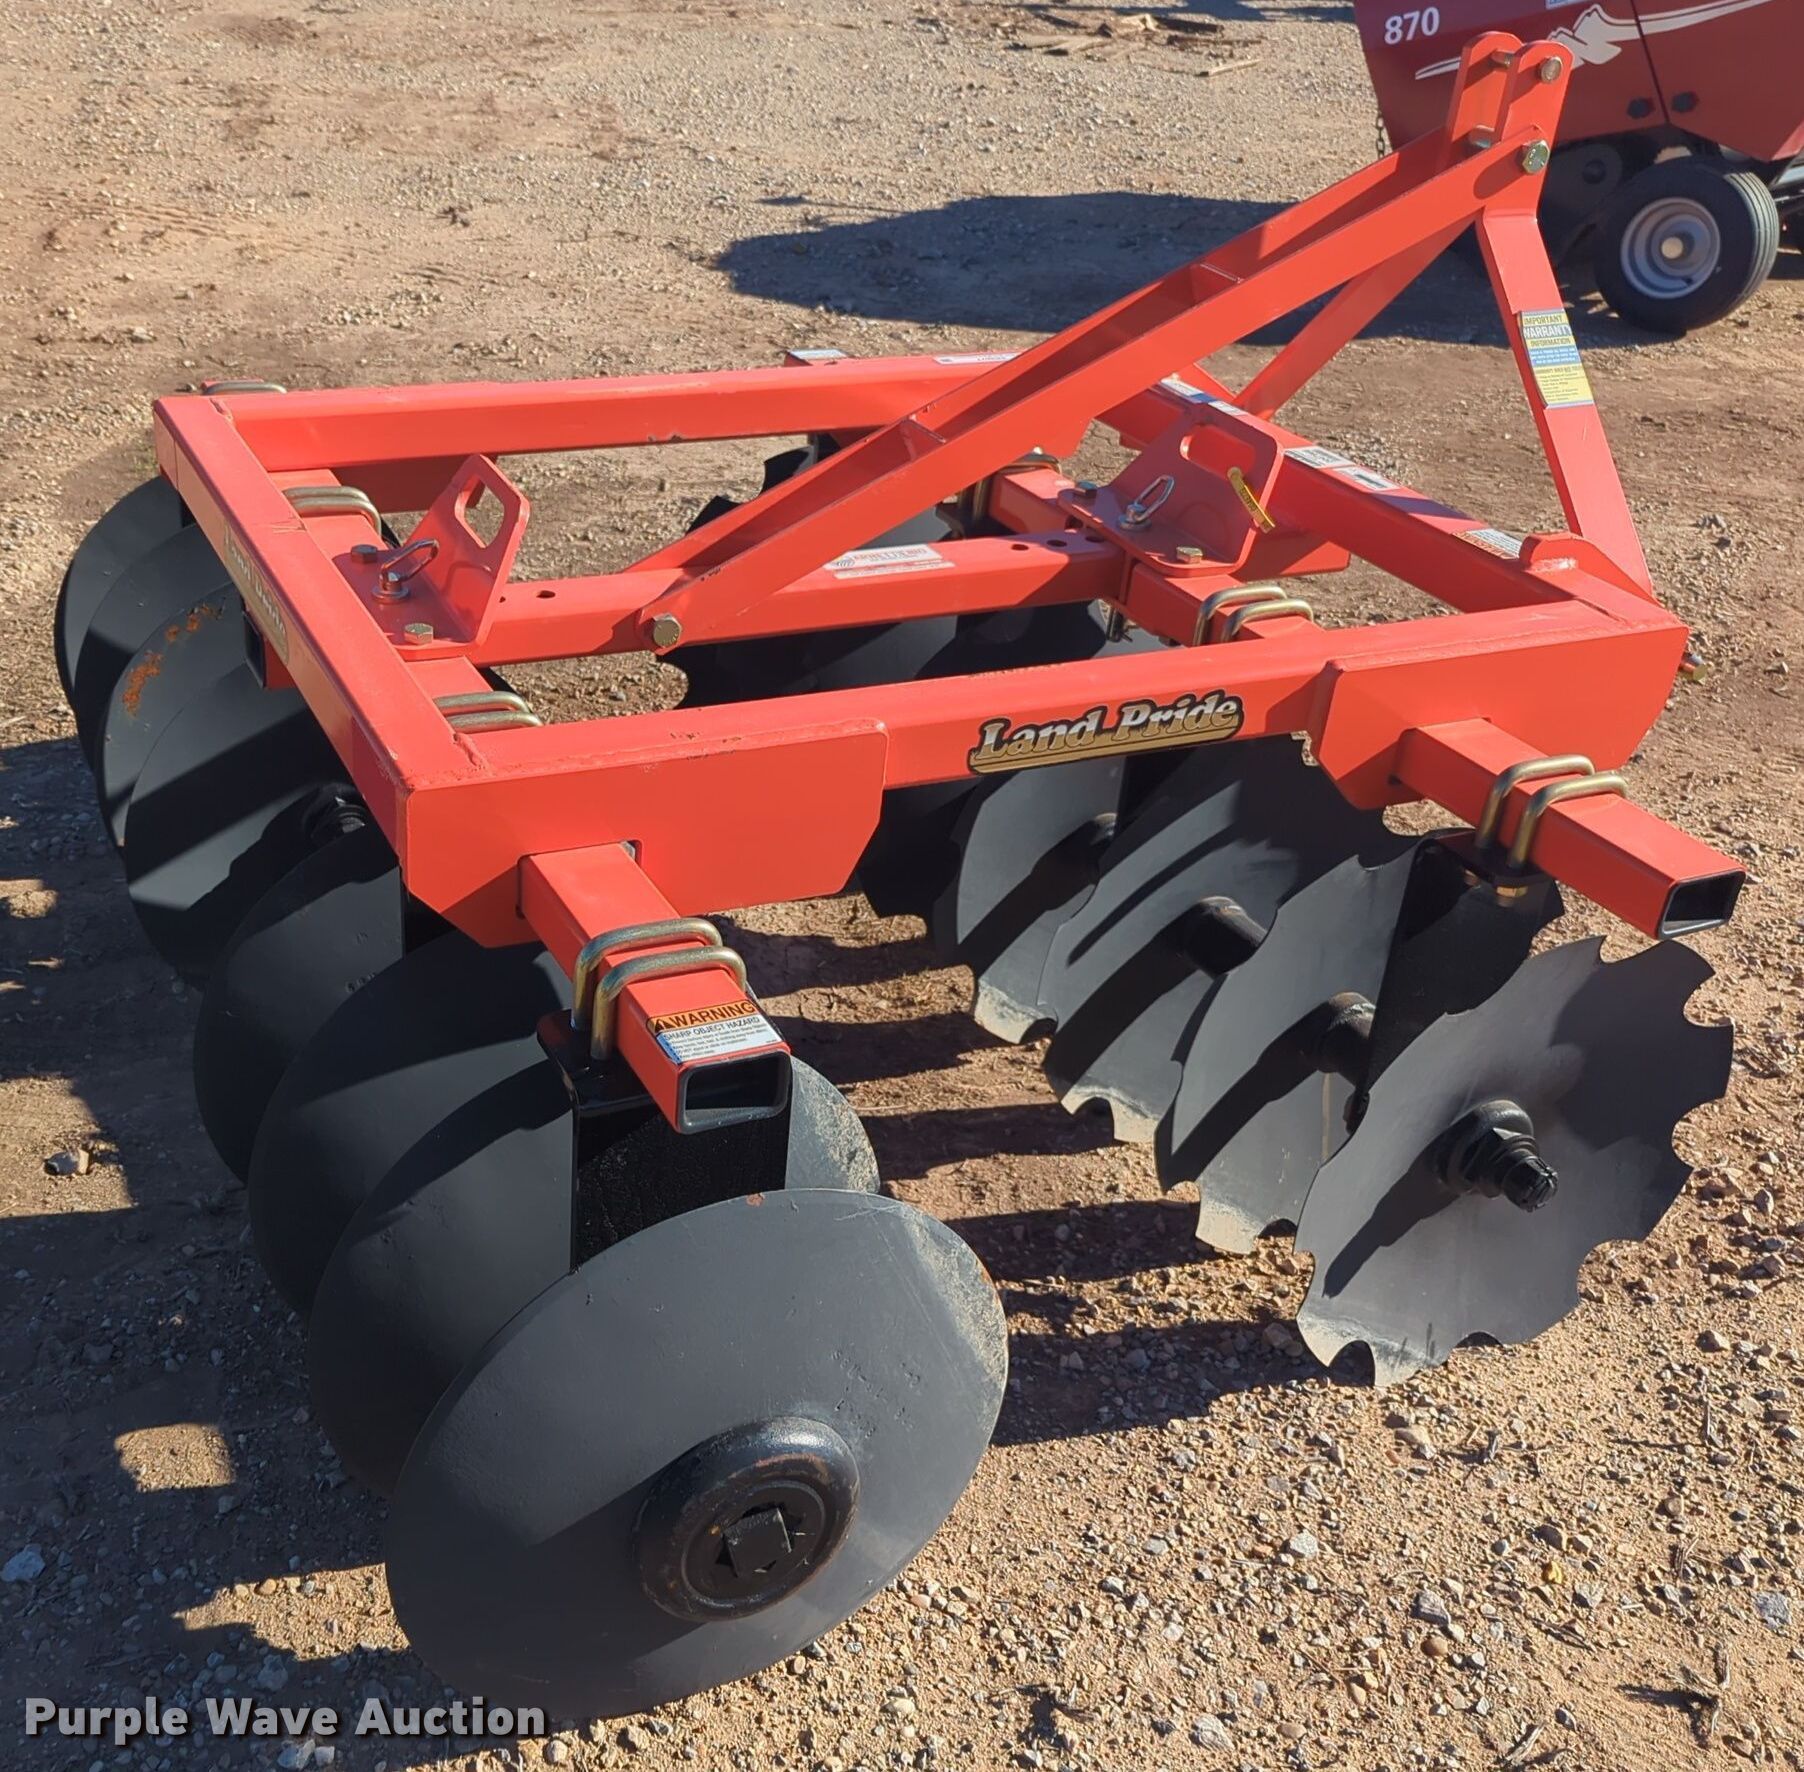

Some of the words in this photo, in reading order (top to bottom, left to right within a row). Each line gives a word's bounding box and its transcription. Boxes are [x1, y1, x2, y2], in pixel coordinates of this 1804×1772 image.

[1384, 6, 1440, 45] 870
[1523, 314, 1563, 325] IMPORTANT
[972, 705, 1108, 763] Land
[1111, 691, 1242, 743] Pride
[669, 1001, 756, 1028] WARNING
[663, 1028, 692, 1041] SHARP
[692, 1023, 725, 1037] OBJECT
[726, 1016, 761, 1030] HAZARD
